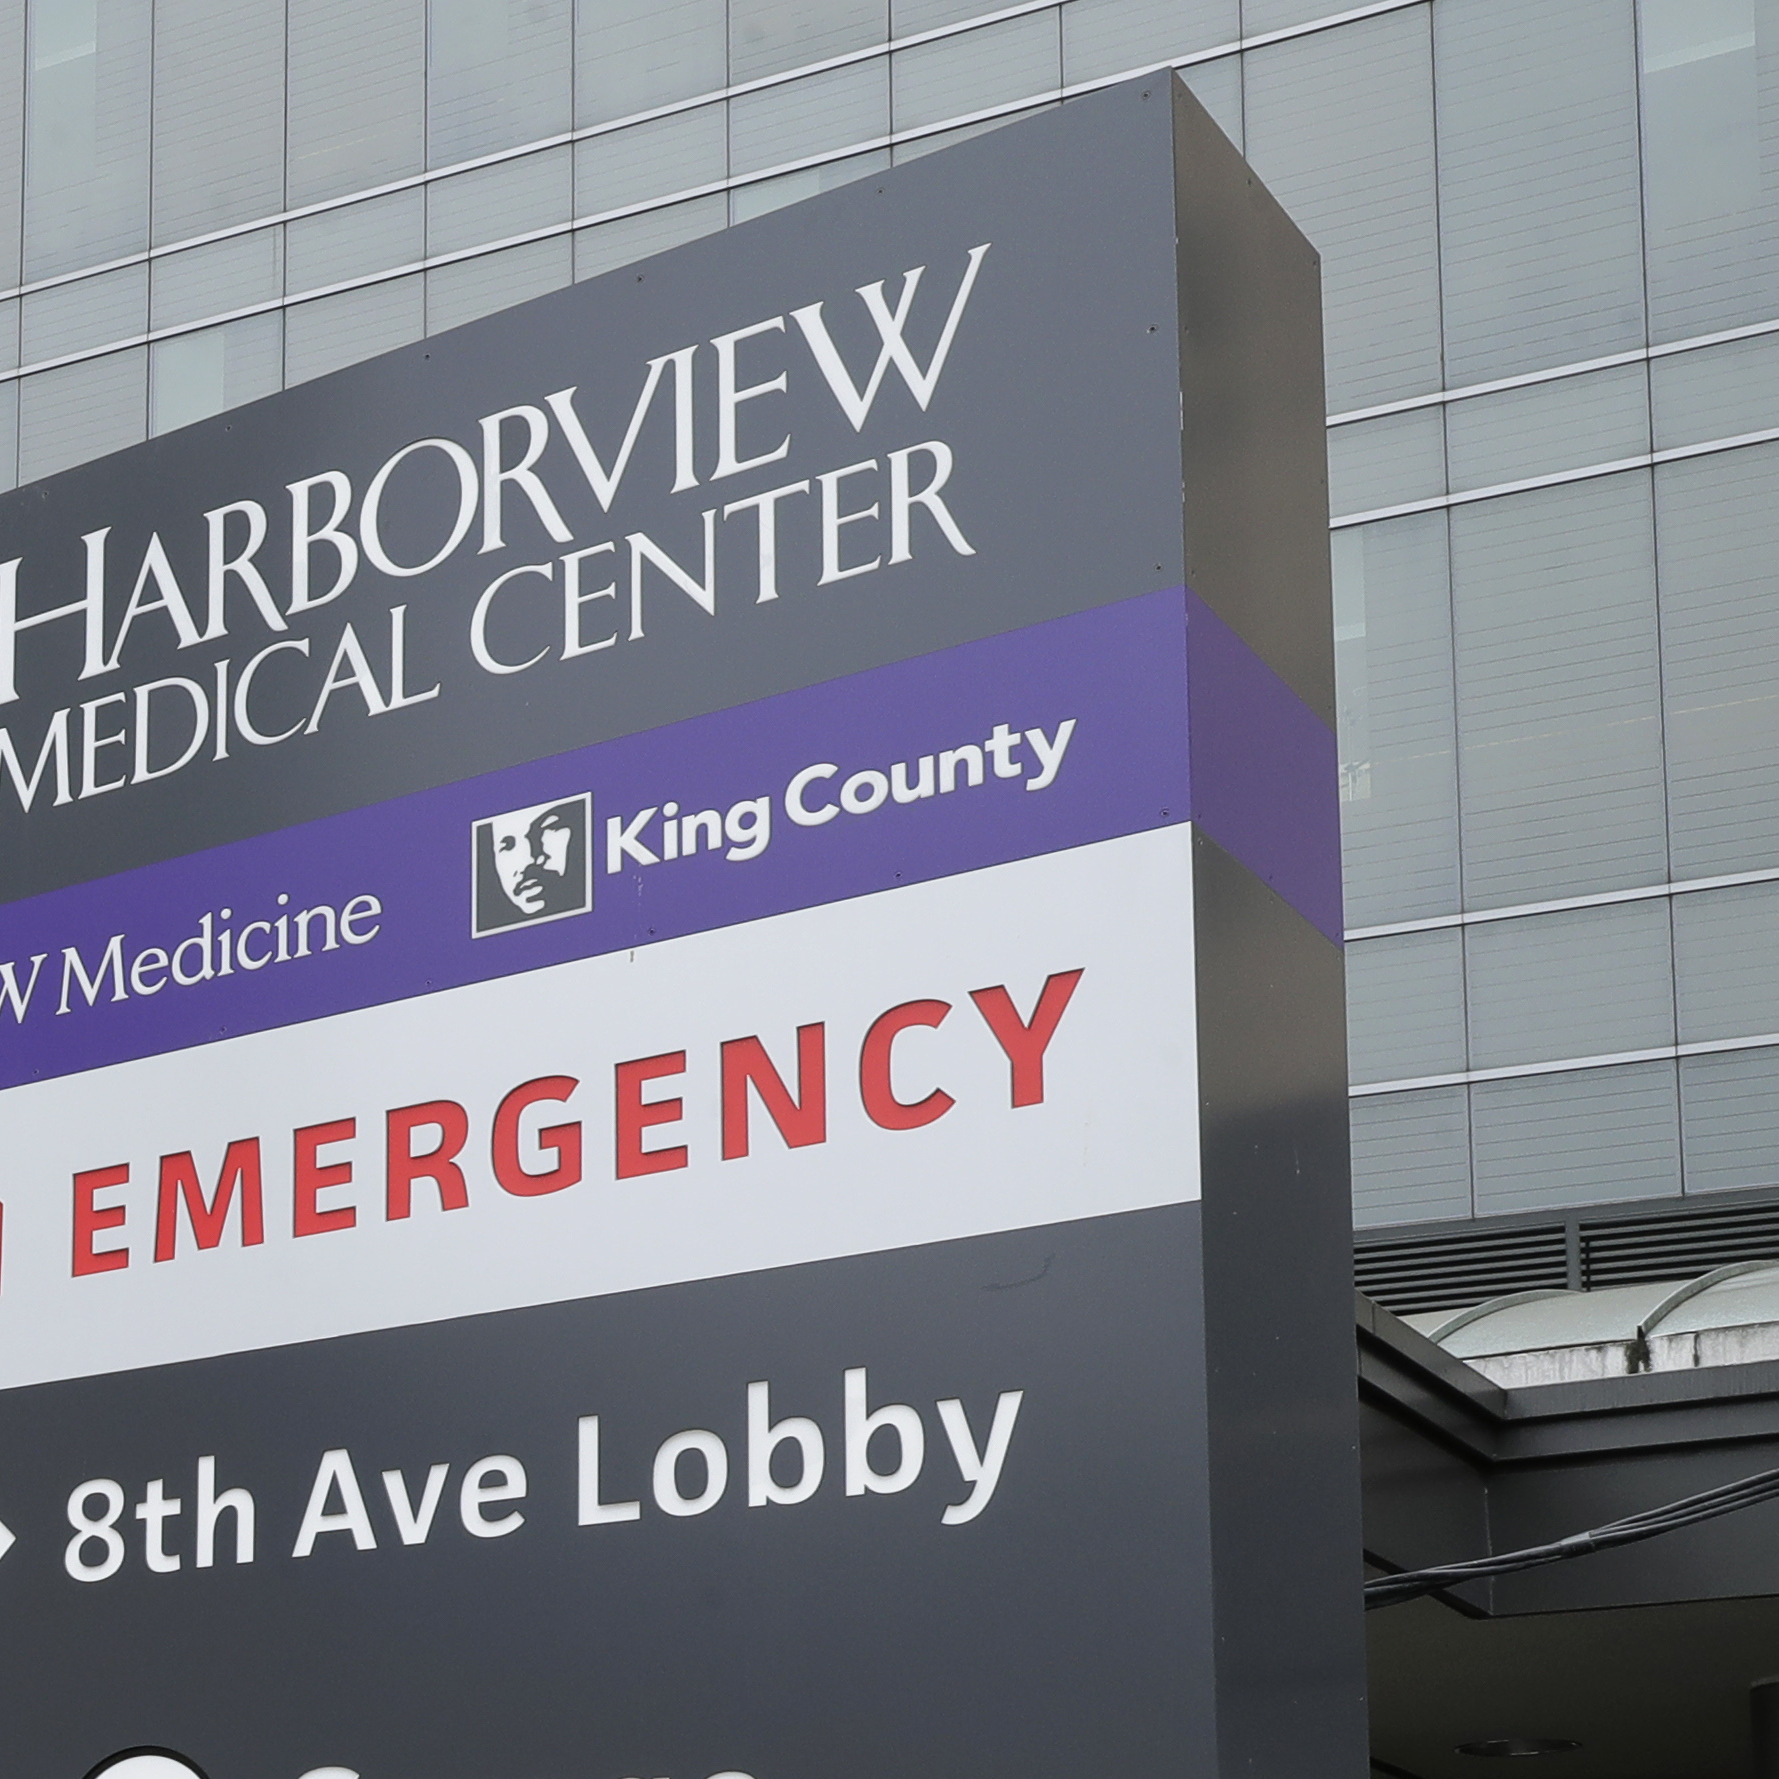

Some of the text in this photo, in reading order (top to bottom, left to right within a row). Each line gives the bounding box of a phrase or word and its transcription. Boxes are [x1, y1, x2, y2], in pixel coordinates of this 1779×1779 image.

[471, 439, 976, 674] CENTER
[607, 719, 1076, 873] King County
[56, 893, 381, 1015] Medicine
[71, 971, 1080, 1277] EMERGENCY
[65, 1368, 1023, 1581] 8th Ave Lobby
